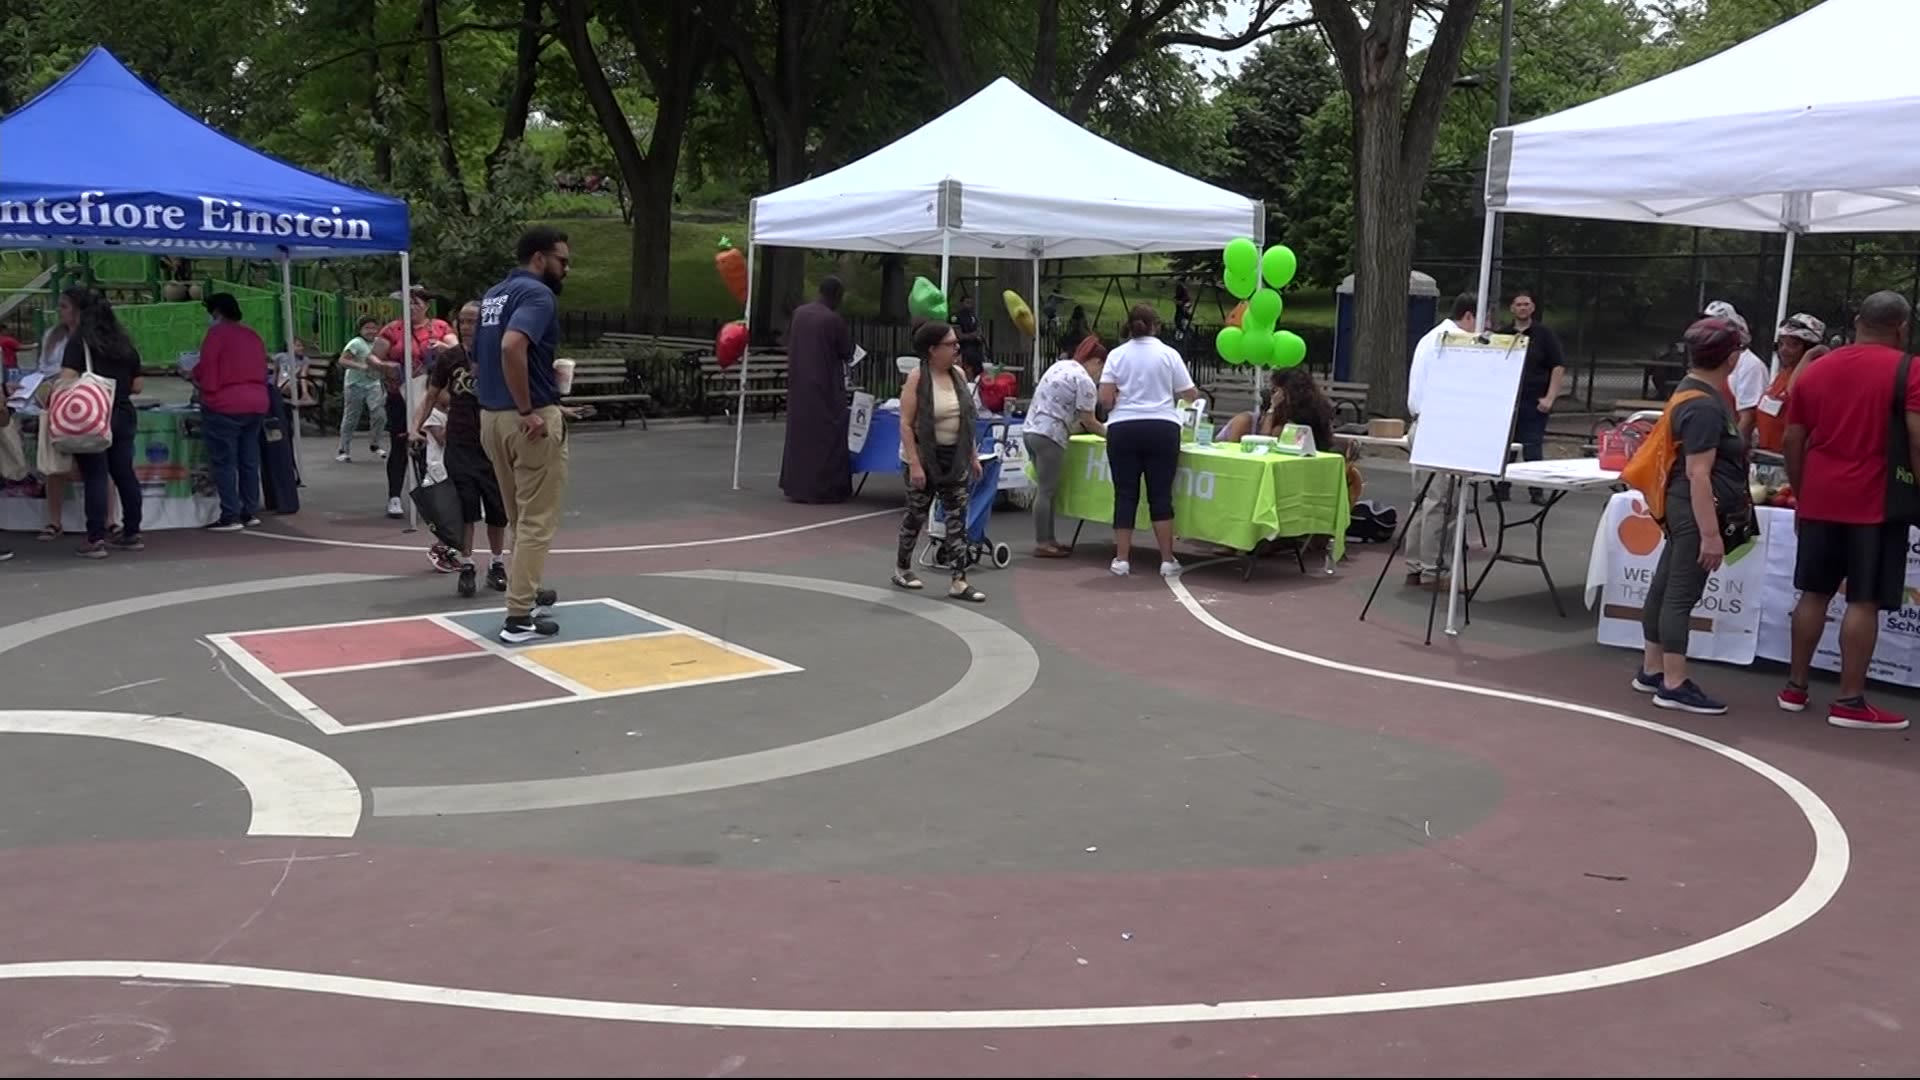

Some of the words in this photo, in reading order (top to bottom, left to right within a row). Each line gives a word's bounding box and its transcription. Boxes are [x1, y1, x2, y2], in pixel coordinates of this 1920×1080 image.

[0, 190, 187, 231] ntefiore
[197, 195, 373, 241] Einstein
[1726, 580, 1743, 594] IN
